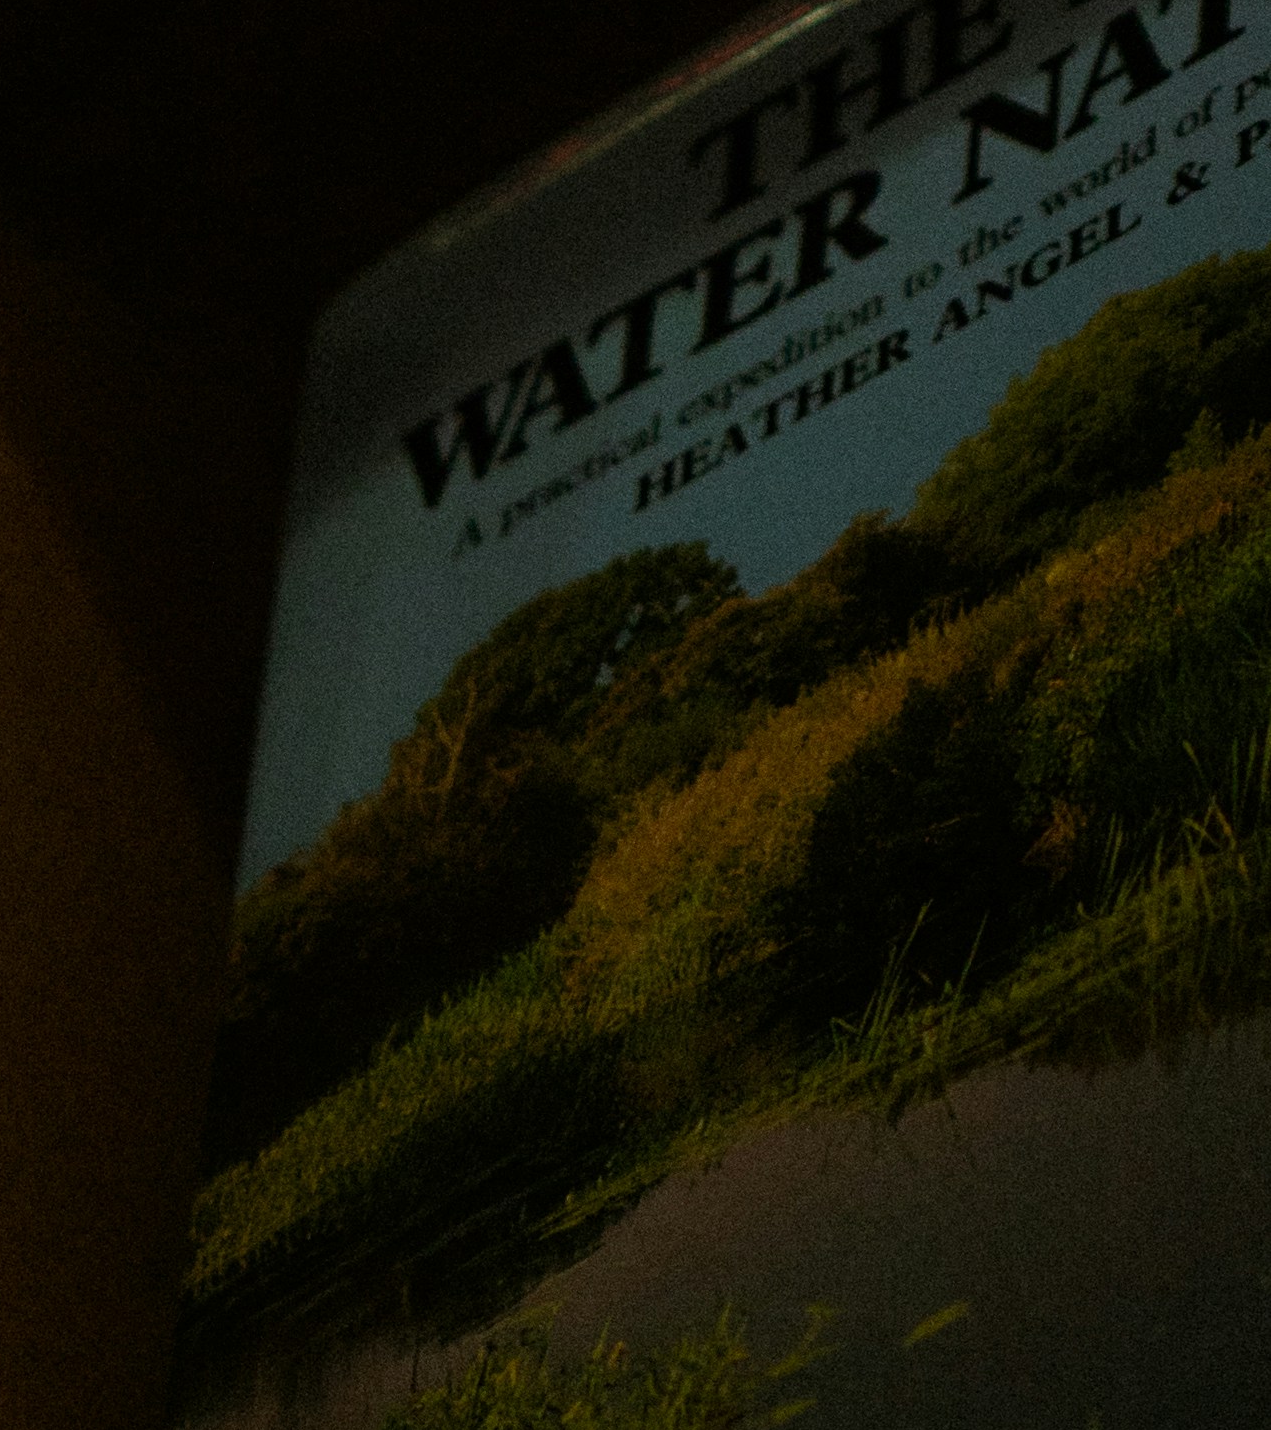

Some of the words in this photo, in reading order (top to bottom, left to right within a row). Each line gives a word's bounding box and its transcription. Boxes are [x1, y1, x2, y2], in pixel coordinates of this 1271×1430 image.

[401, 170, 889, 508] WATER
[501, 416, 661, 538] practical
[677, 295, 885, 426] expedition
[905, 262, 943, 298] to
[959, 215, 1023, 268] the
[1039, 125, 1157, 216] world
[1173, 84, 1223, 140] of
[635, 330, 911, 512] HEATHER
[931, 202, 1143, 346] ANGEL
[1165, 162, 1209, 206] &
